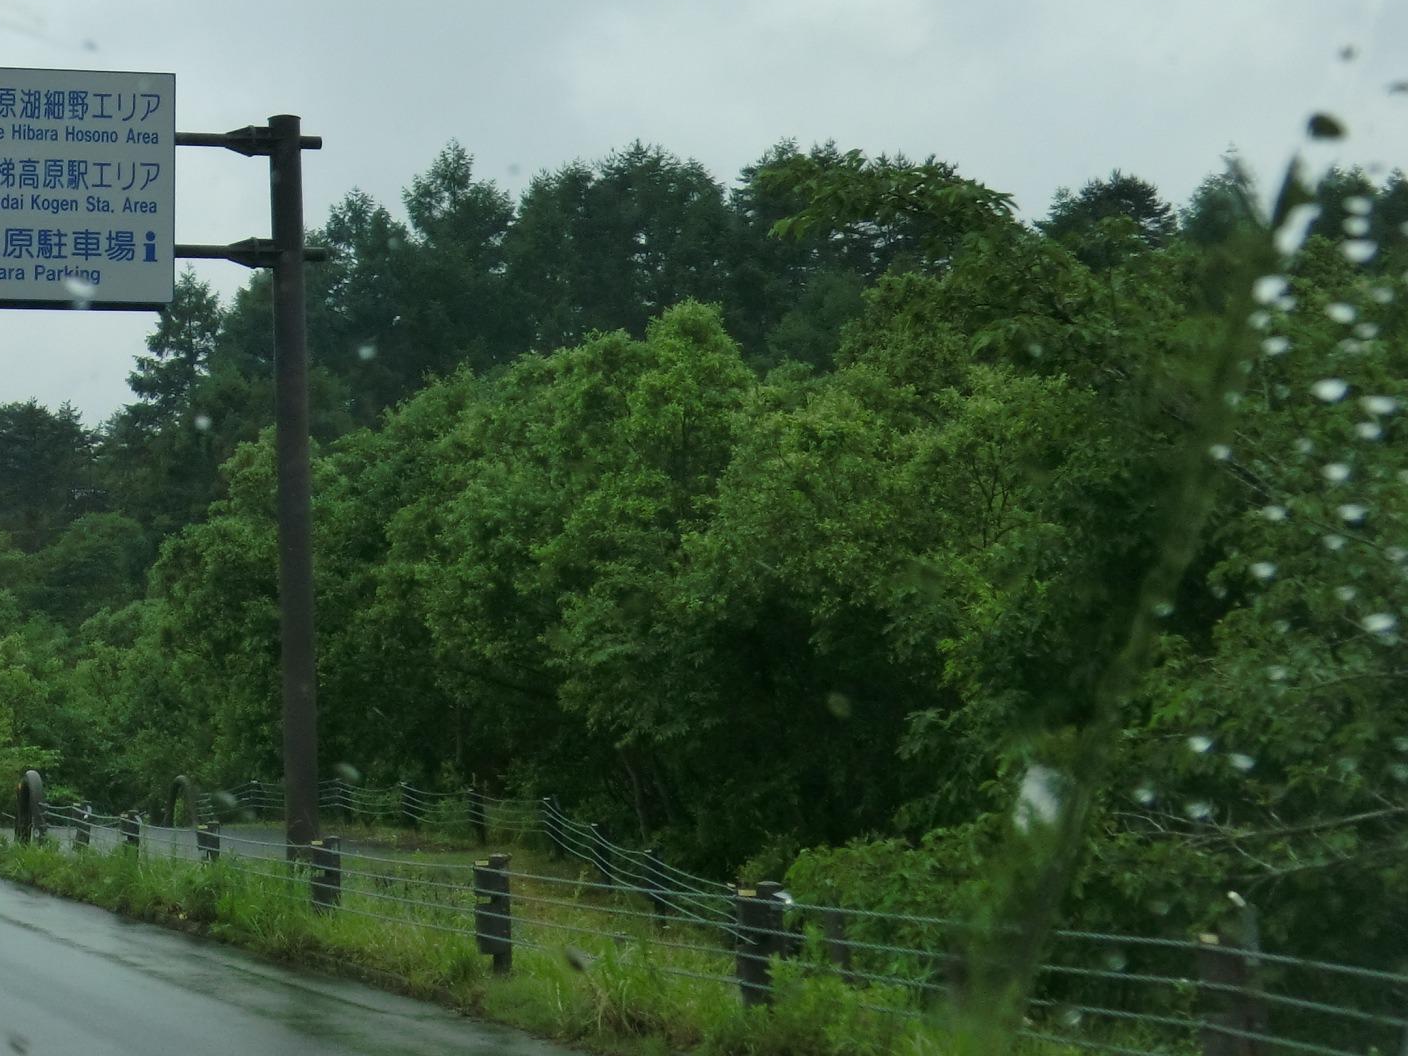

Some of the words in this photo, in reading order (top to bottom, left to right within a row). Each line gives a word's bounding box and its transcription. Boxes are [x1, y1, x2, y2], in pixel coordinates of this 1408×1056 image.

[11, 124, 58, 142] Hibara
[65, 126, 118, 143] Hosono
[126, 128, 159, 144] Area
[31, 194, 78, 214] Kogen
[86, 196, 114, 213] Sta.
[122, 197, 157, 214] Area
[34, 264, 101, 285] Parking
